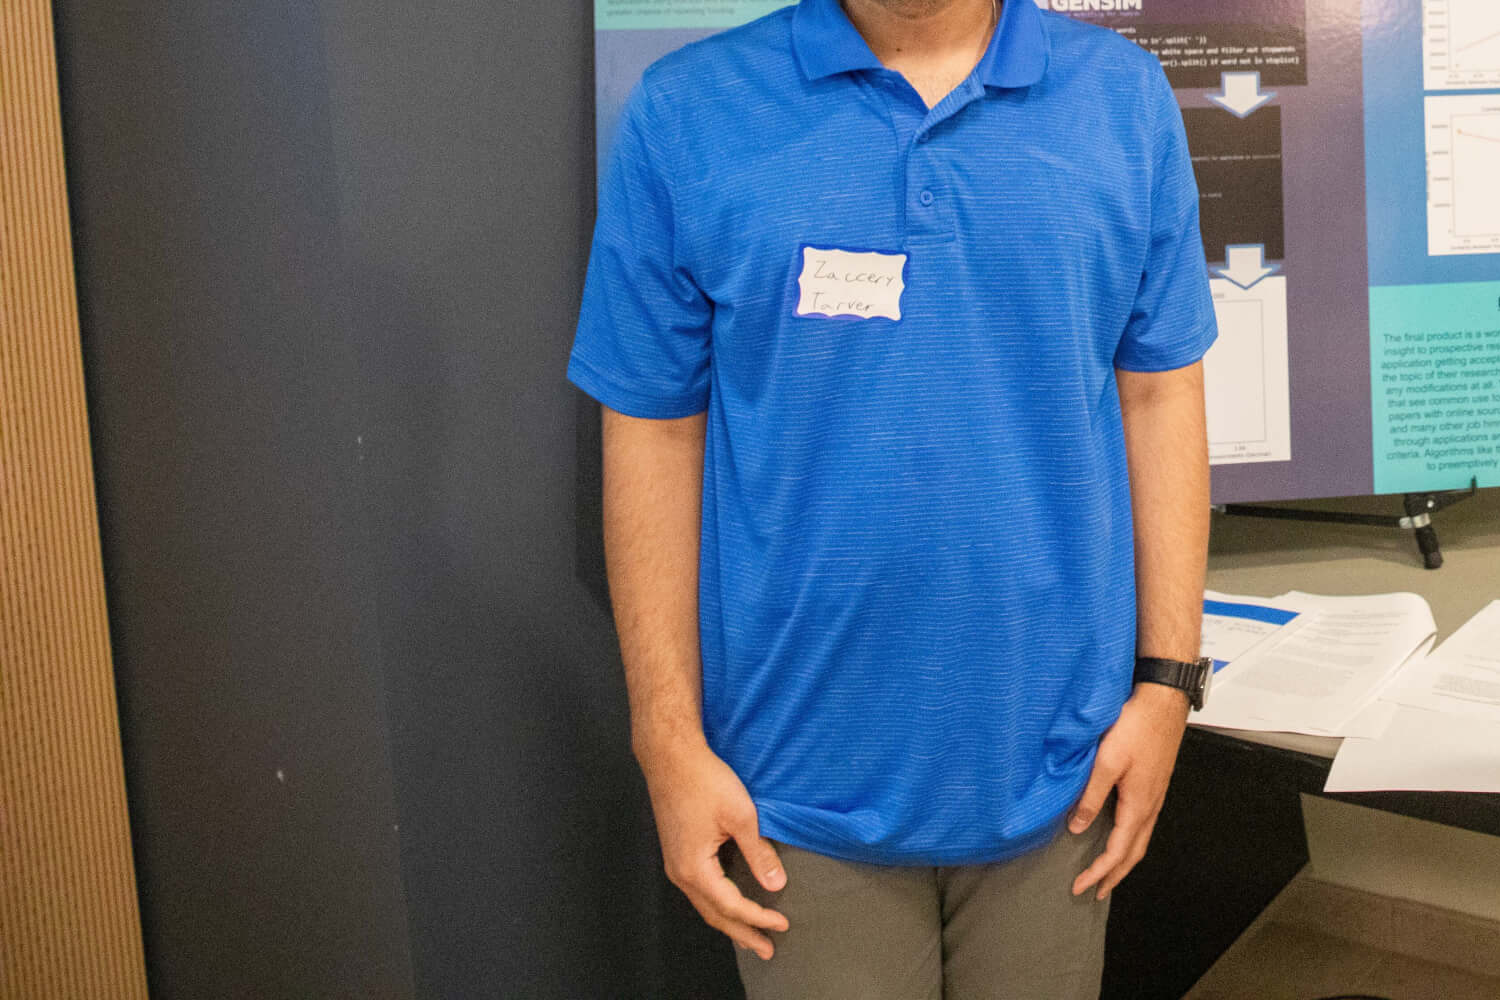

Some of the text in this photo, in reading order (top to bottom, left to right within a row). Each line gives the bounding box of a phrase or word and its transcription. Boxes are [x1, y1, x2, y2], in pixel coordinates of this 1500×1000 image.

[814, 260, 895, 286] Zaccery
[812, 292, 875, 311] Tarver
[1427, 331, 1462, 342] product
[1429, 343, 1482, 355] prospective
[1382, 359, 1432, 370] application
[1461, 368, 1500, 377] research
[1406, 382, 1468, 393] modifications
[1432, 433, 1488, 445] applications
[1438, 458, 1498, 471] preemptively
